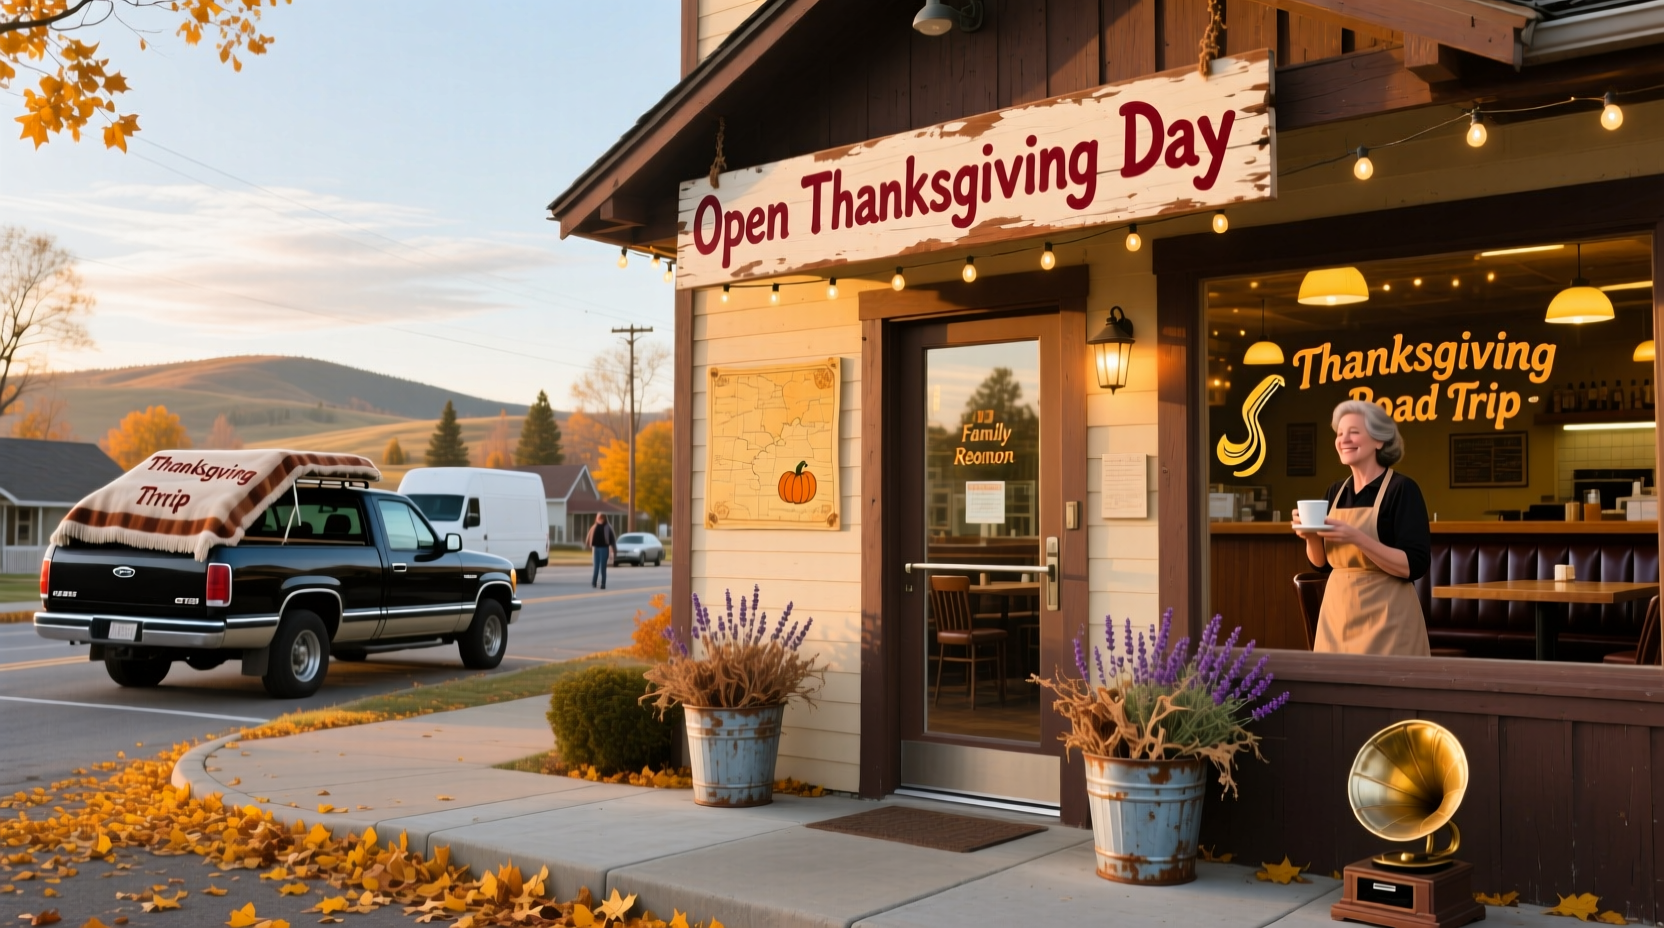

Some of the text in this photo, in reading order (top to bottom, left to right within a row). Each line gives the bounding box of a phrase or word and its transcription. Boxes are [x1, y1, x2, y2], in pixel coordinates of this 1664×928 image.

[693, 101, 1236, 269] Open Thanksgiving Day
[1292, 331, 1557, 390] Thanksgiving
[1447, 381, 1521, 430] Trip
[961, 422, 1012, 447] Family
